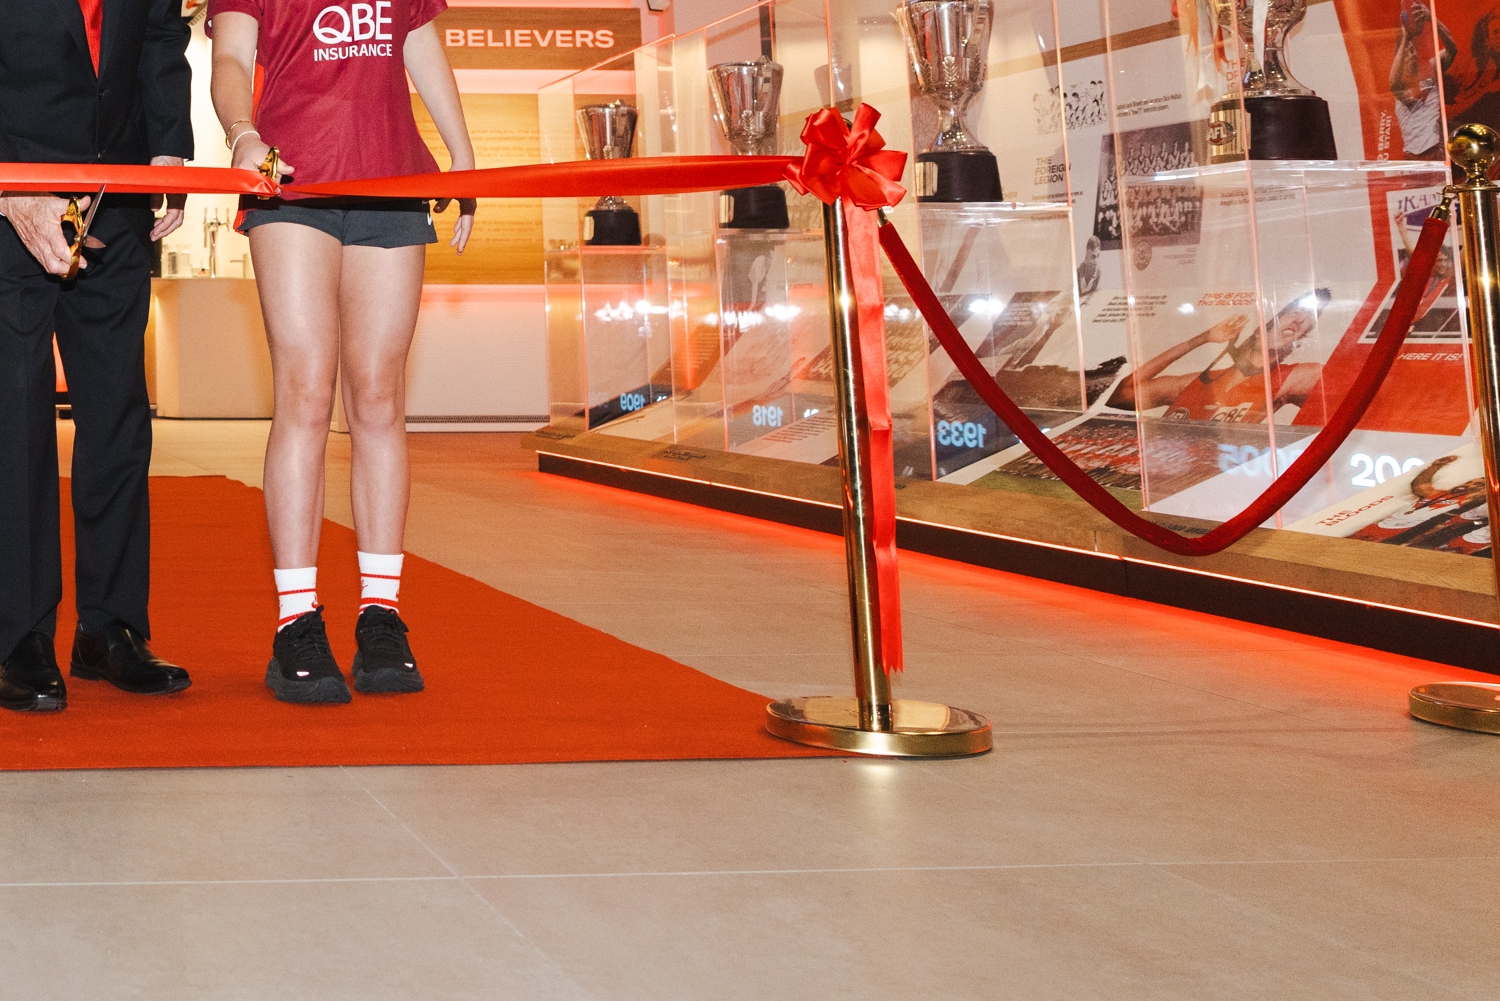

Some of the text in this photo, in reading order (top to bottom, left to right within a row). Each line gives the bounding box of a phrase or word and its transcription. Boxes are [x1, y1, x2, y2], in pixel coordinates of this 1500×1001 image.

[313, 1, 393, 44] QBE
[445, 29, 615, 48] BELIEVERS
[314, 44, 393, 62] INSURANCE
[1207, 127, 1228, 140] AFL
[1036, 156, 1052, 166] THE
[1035, 163, 1071, 175] FOREIGN
[1034, 174, 1065, 185] LEGION
[1397, 353, 1431, 361] HERE
[1325, 495, 1395, 527] BLOODS
